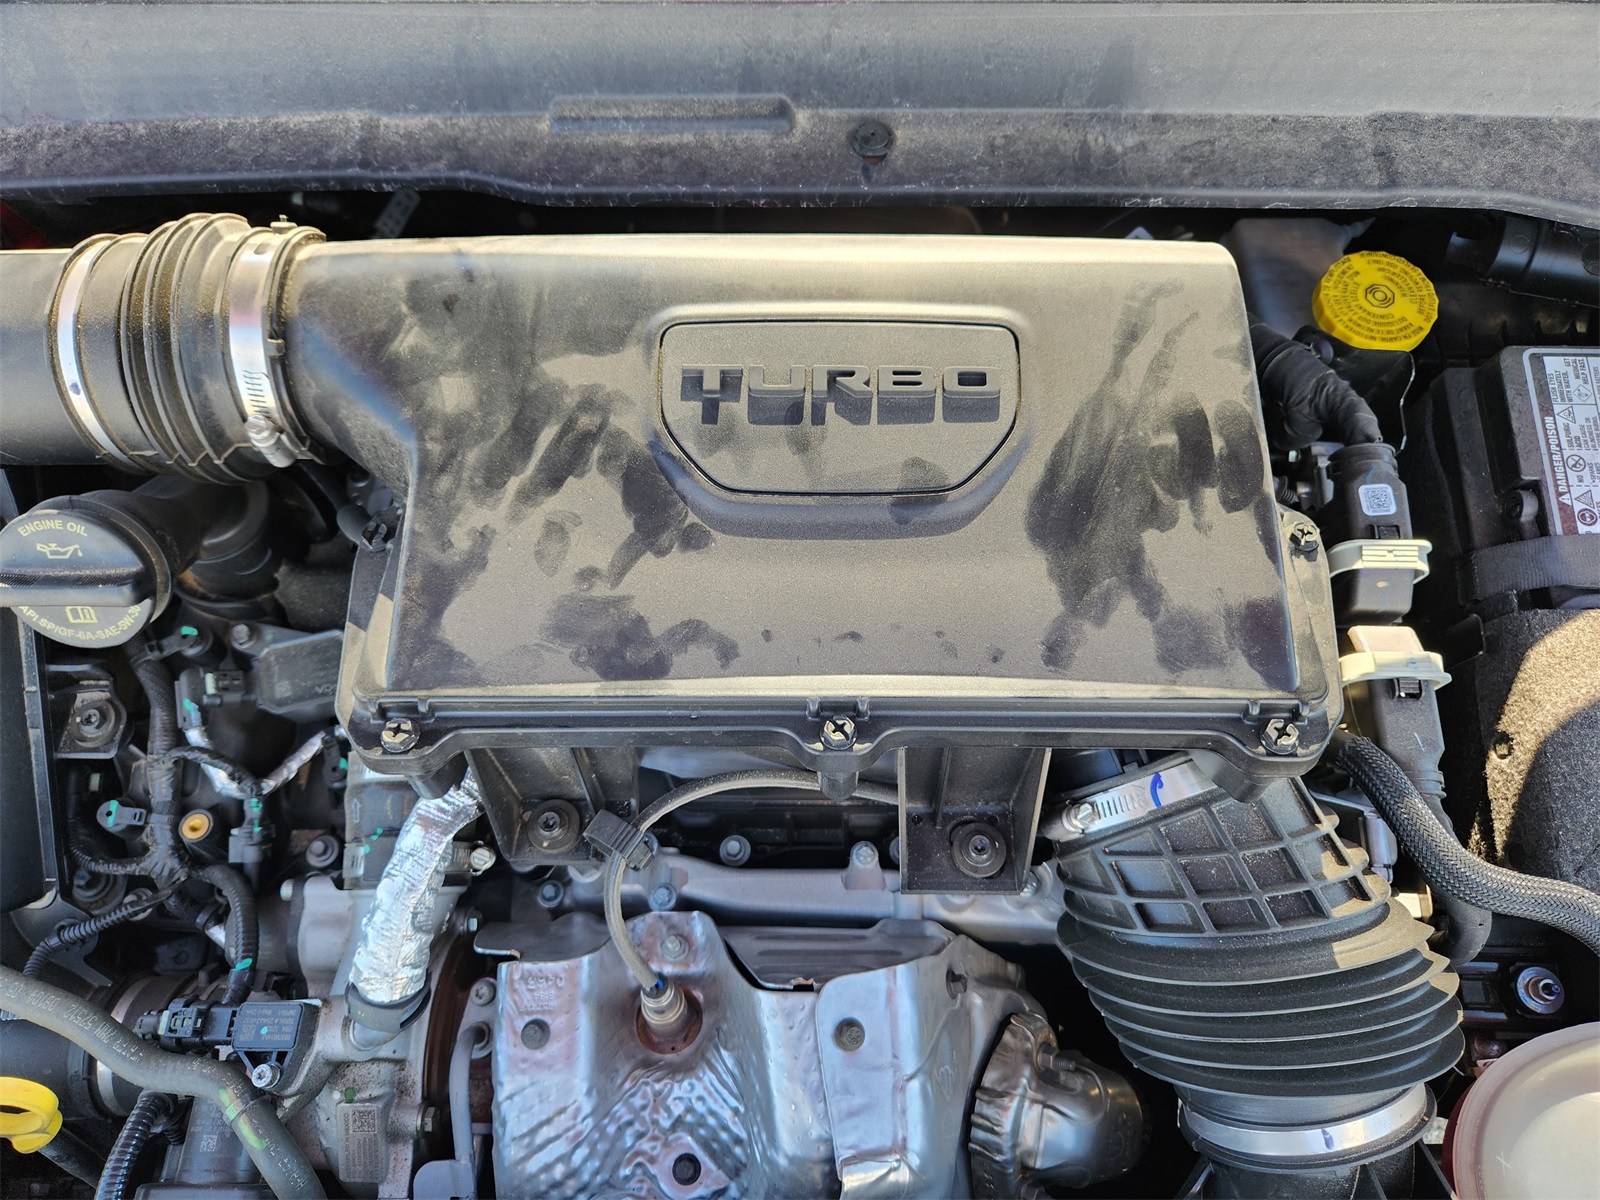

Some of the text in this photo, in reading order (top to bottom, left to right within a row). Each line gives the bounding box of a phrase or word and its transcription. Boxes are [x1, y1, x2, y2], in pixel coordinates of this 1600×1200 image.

[1562, 371, 1571, 389] WATER.
[1572, 358, 1581, 380] MEDICAL
[1578, 358, 1589, 385] HELP FAST.
[680, 364, 1001, 404] TURBO
[1551, 387, 1559, 402] FLUSH
[1554, 370, 1566, 402] IMMEDIATELY
[1563, 422, 1574, 448] SULFURIC
[1574, 436, 1582, 448] ACID
[1579, 424, 1590, 448] CAN CAUSE
[1586, 424, 1596, 448] BLINDNESS
[1545, 416, 1568, 493] DANGER/POISON
[1577, 475, 1584, 483] NO
[17, 519, 88, 537] ENGINE OIL
[19, 605, 39, 621] API
